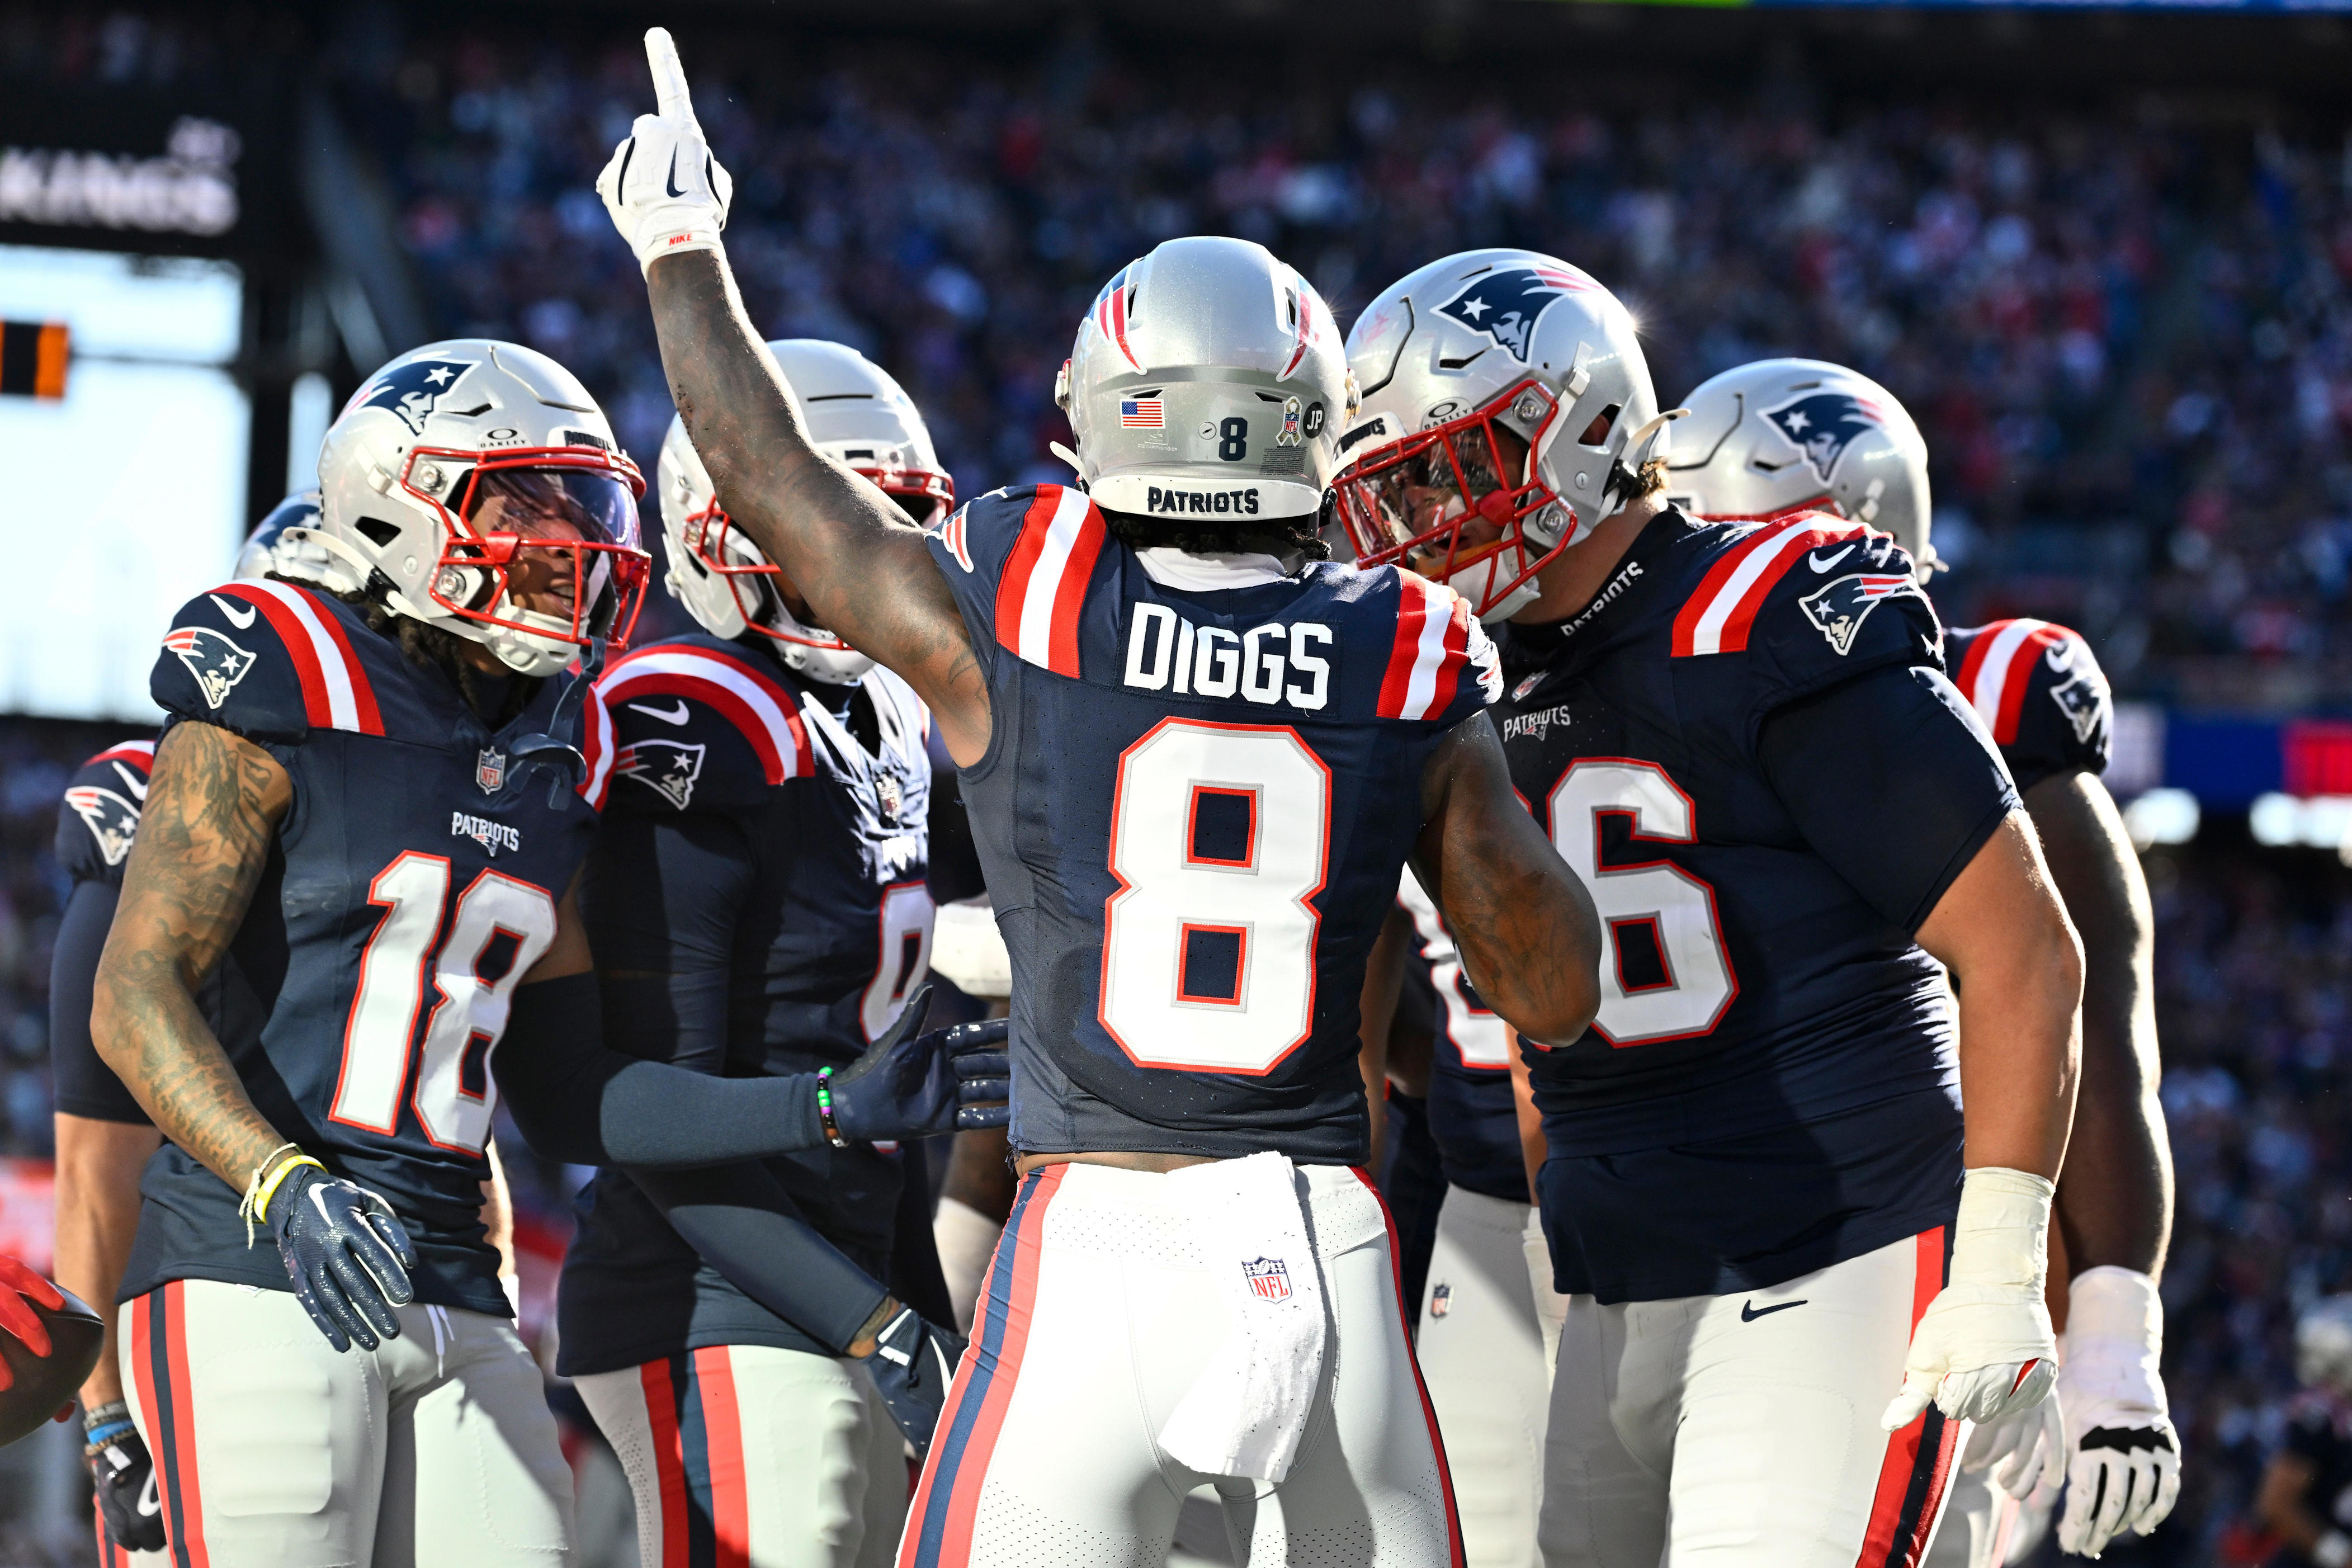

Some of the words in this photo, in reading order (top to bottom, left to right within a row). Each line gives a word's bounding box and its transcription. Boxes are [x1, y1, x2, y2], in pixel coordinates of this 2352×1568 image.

[669, 233, 692, 246] NIKE
[1285, 421, 1297, 432] NFL
[1306, 410, 1323, 430] JP
[1424, 409, 1468, 430] OAKLEY
[480, 440, 525, 448] OAKLEY
[1218, 417, 1248, 461] 8
[1147, 486, 1258, 514] PATRIOTS
[1123, 602, 1333, 711] DIGGS
[1504, 705, 1571, 743] PATRIOTS
[481, 768, 499, 785] NFL
[452, 811, 519, 852] PATRIOTS
[1097, 716, 1333, 1076] 8
[328, 850, 557, 1159] 18
[1251, 1276, 1288, 1299] NFL
